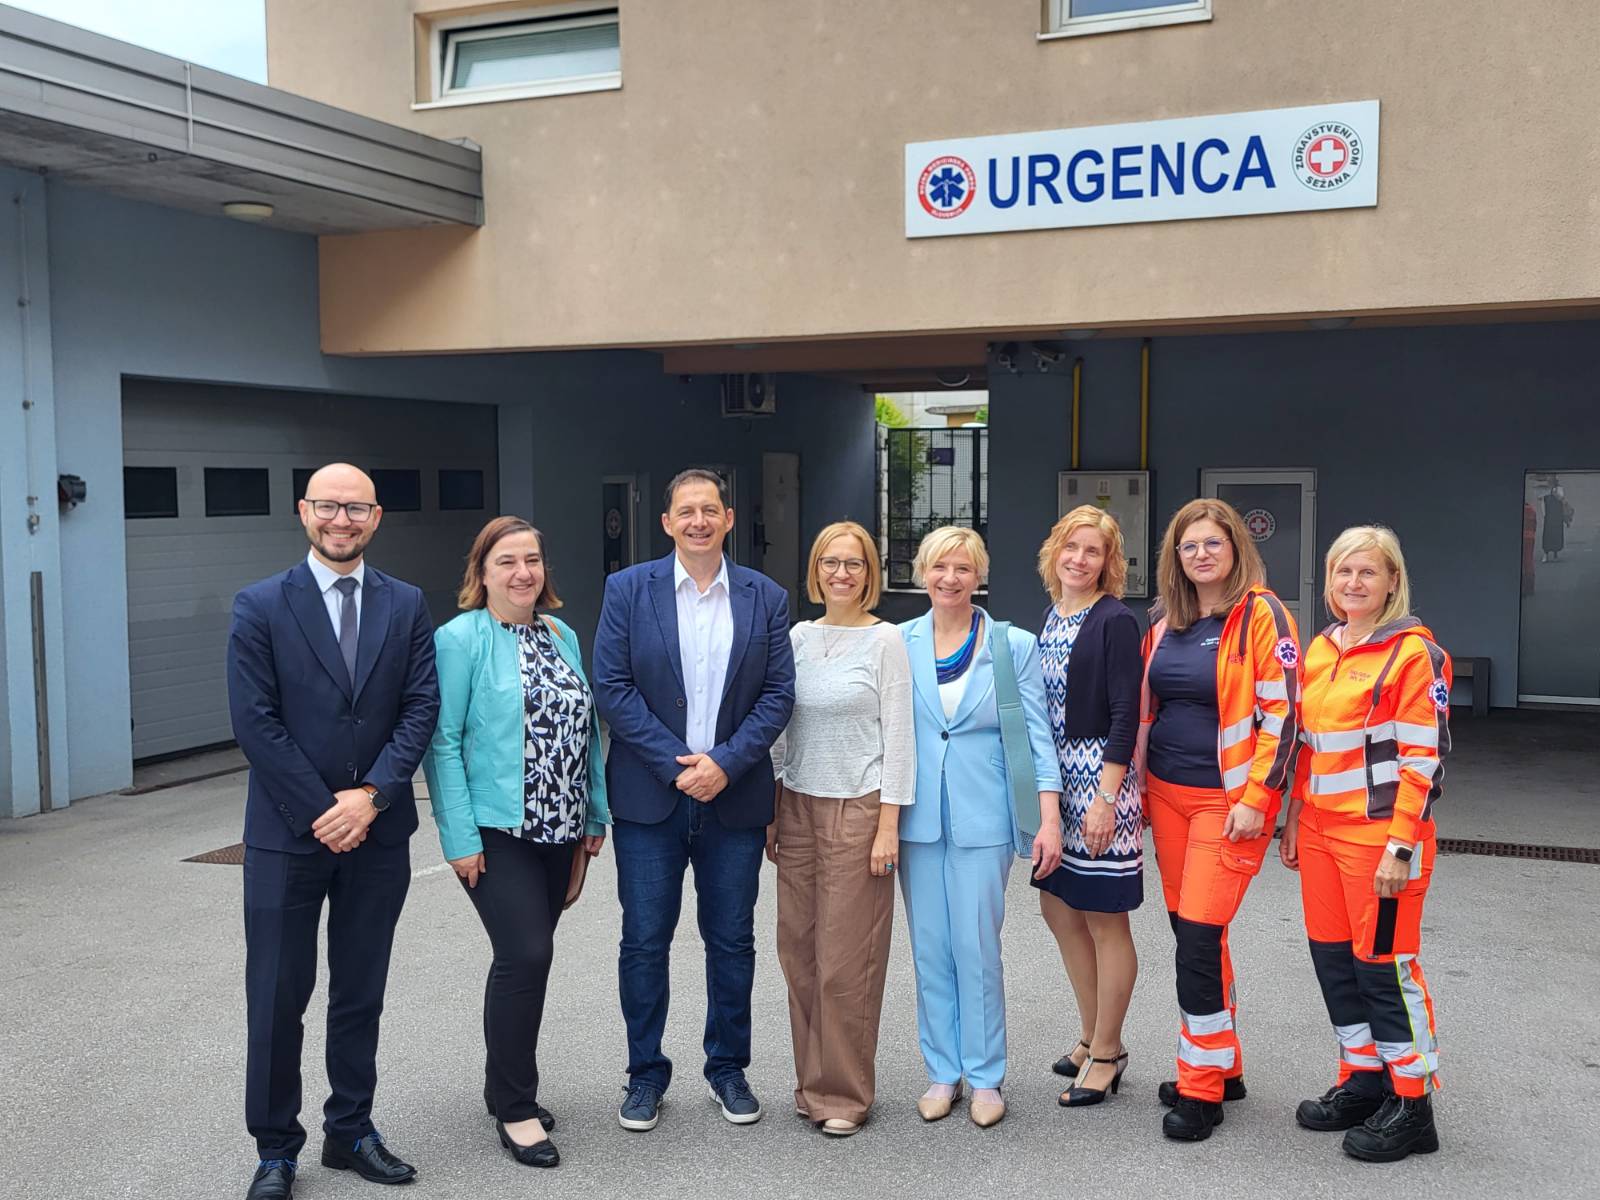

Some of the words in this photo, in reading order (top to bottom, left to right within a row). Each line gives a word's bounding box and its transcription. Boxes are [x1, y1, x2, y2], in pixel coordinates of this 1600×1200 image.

[1296, 125, 1352, 170] ZDRAVSTVENI
[1350, 140, 1359, 166] DOM
[989, 136, 1276, 208] URGENCA
[1305, 173, 1350, 188] SEŽANA
